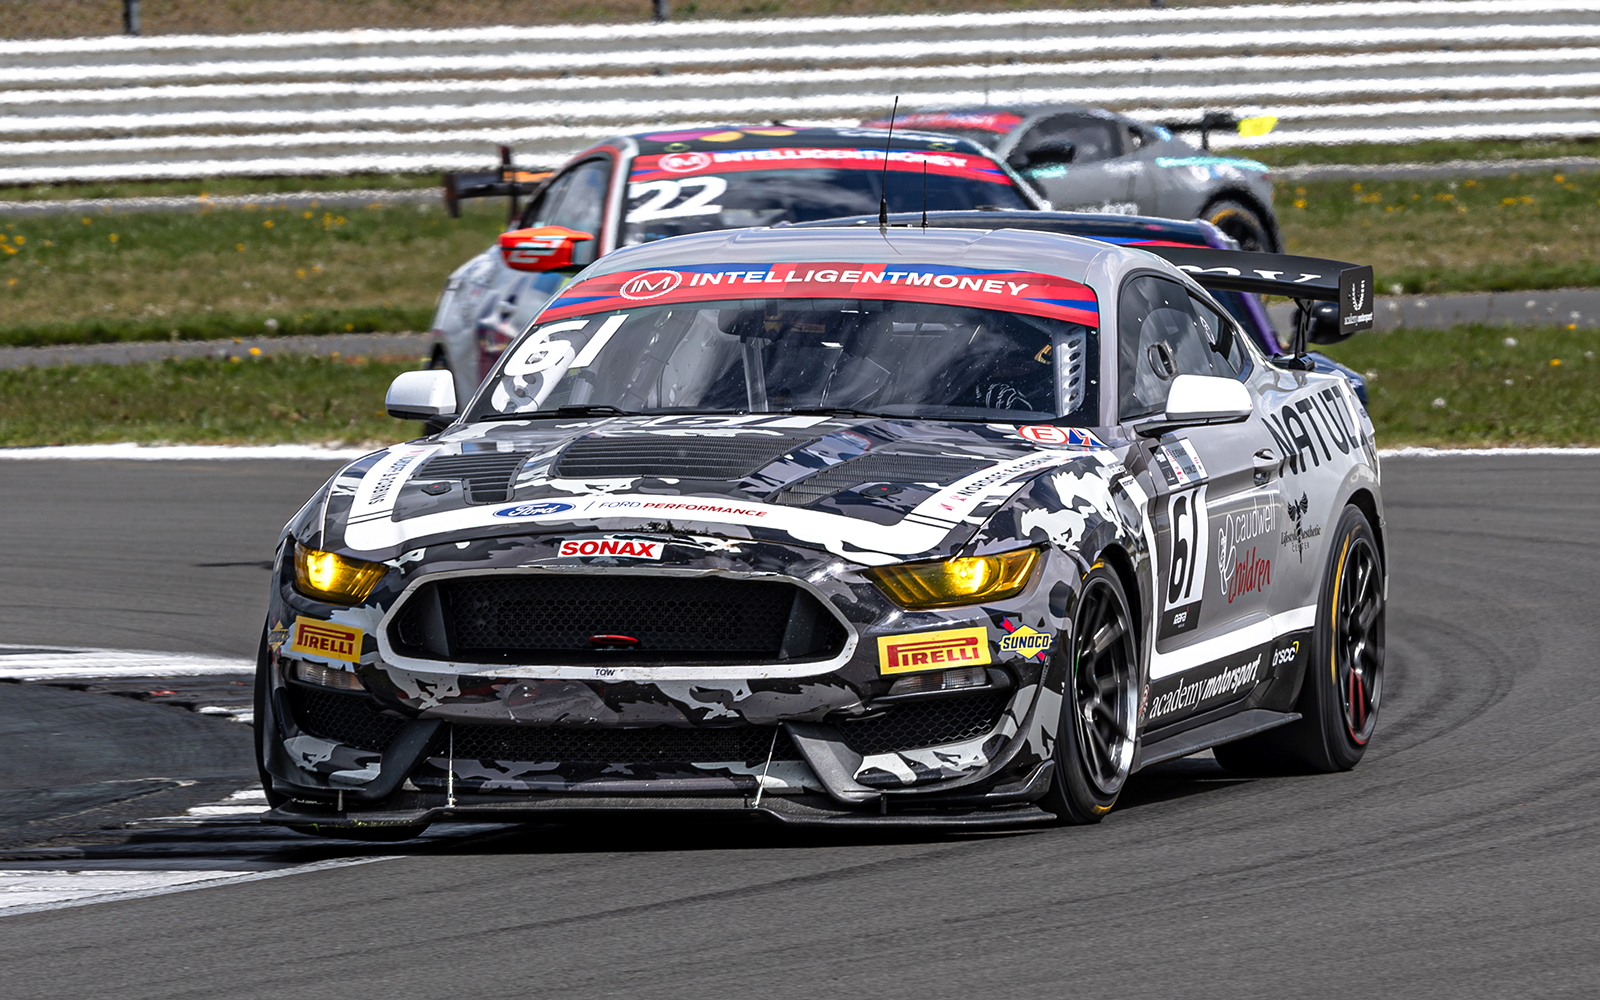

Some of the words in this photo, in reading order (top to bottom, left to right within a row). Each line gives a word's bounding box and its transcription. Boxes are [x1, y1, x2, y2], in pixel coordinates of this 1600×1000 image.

[625, 177, 727, 224] 22
[689, 269, 1029, 296] INTELLIGENTMONEY
[504, 314, 629, 376] 61
[508, 503, 557, 517] Ford
[599, 501, 640, 509] FORD
[643, 502, 767, 518] PERFORMANCE
[1235, 492, 1276, 544] caudwell
[561, 541, 656, 558] SONAX
[1168, 490, 1198, 604] 61
[297, 623, 355, 655] PIRELLI
[886, 636, 980, 668] PIRELLI
[1003, 635, 1050, 650] SUNOCO
[595, 668, 616, 677] TOW
